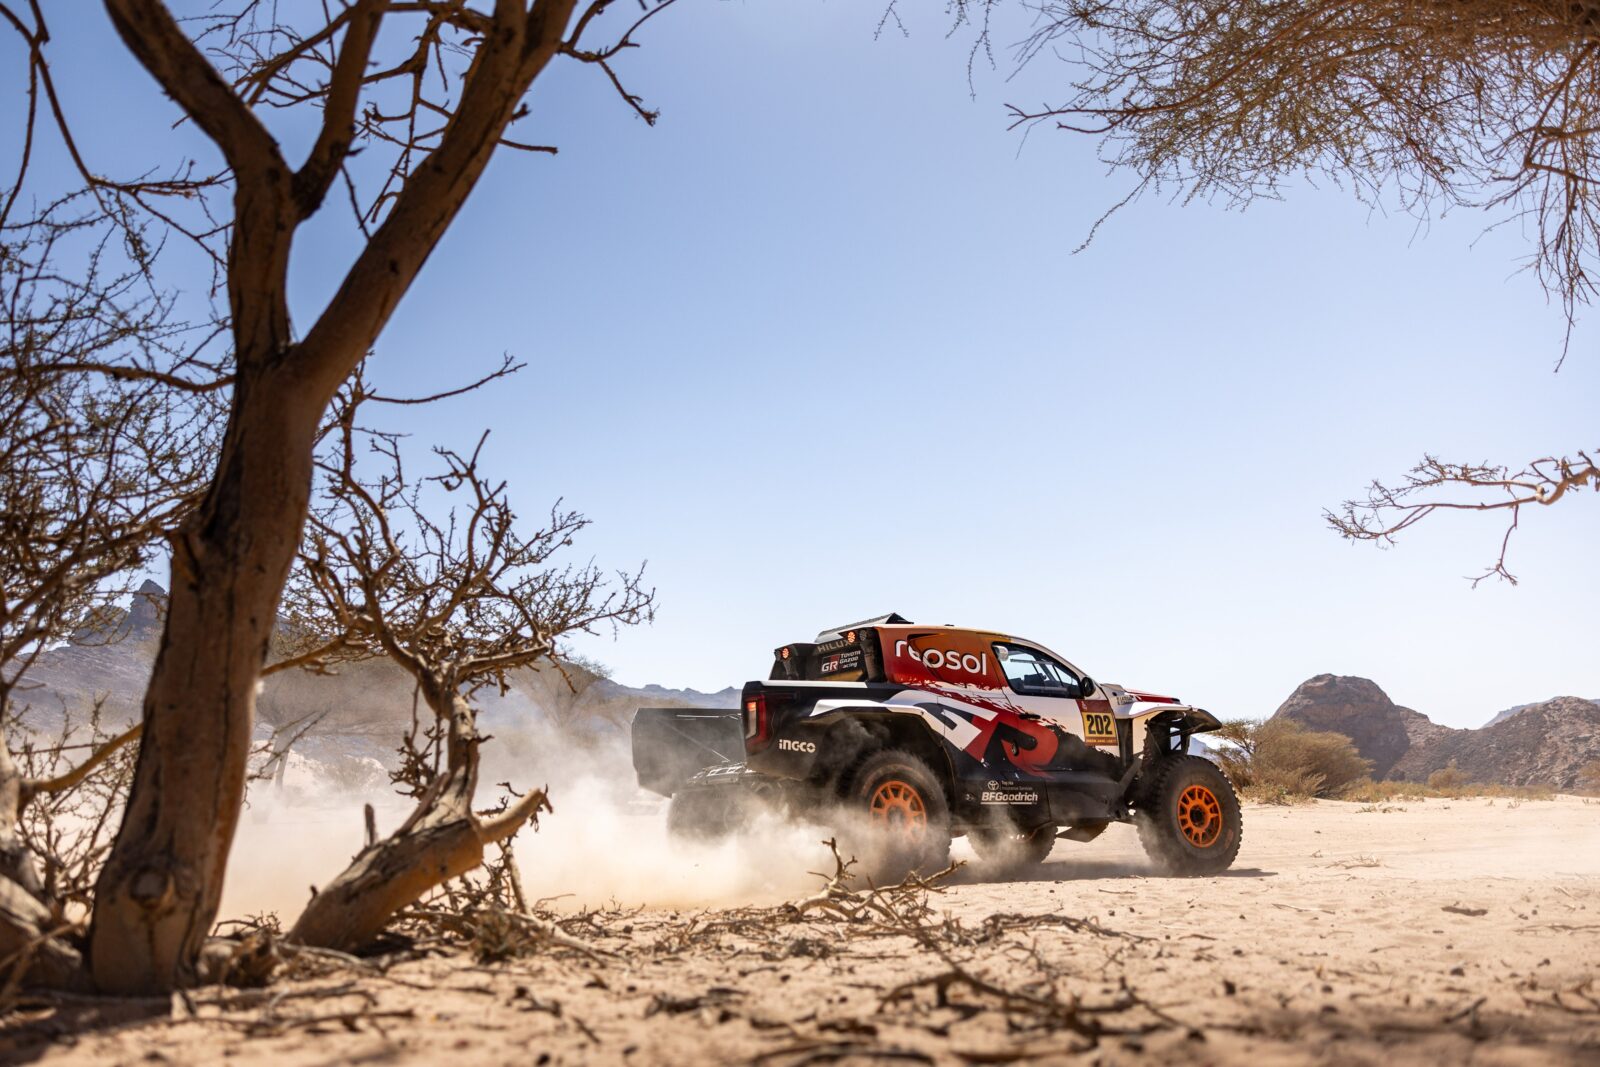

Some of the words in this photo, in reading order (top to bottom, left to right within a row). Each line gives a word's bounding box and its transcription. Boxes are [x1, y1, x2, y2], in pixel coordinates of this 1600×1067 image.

[821, 661, 838, 672] GR
[1086, 714, 1112, 735] 202
[981, 792, 1038, 801] BFGoodrich
